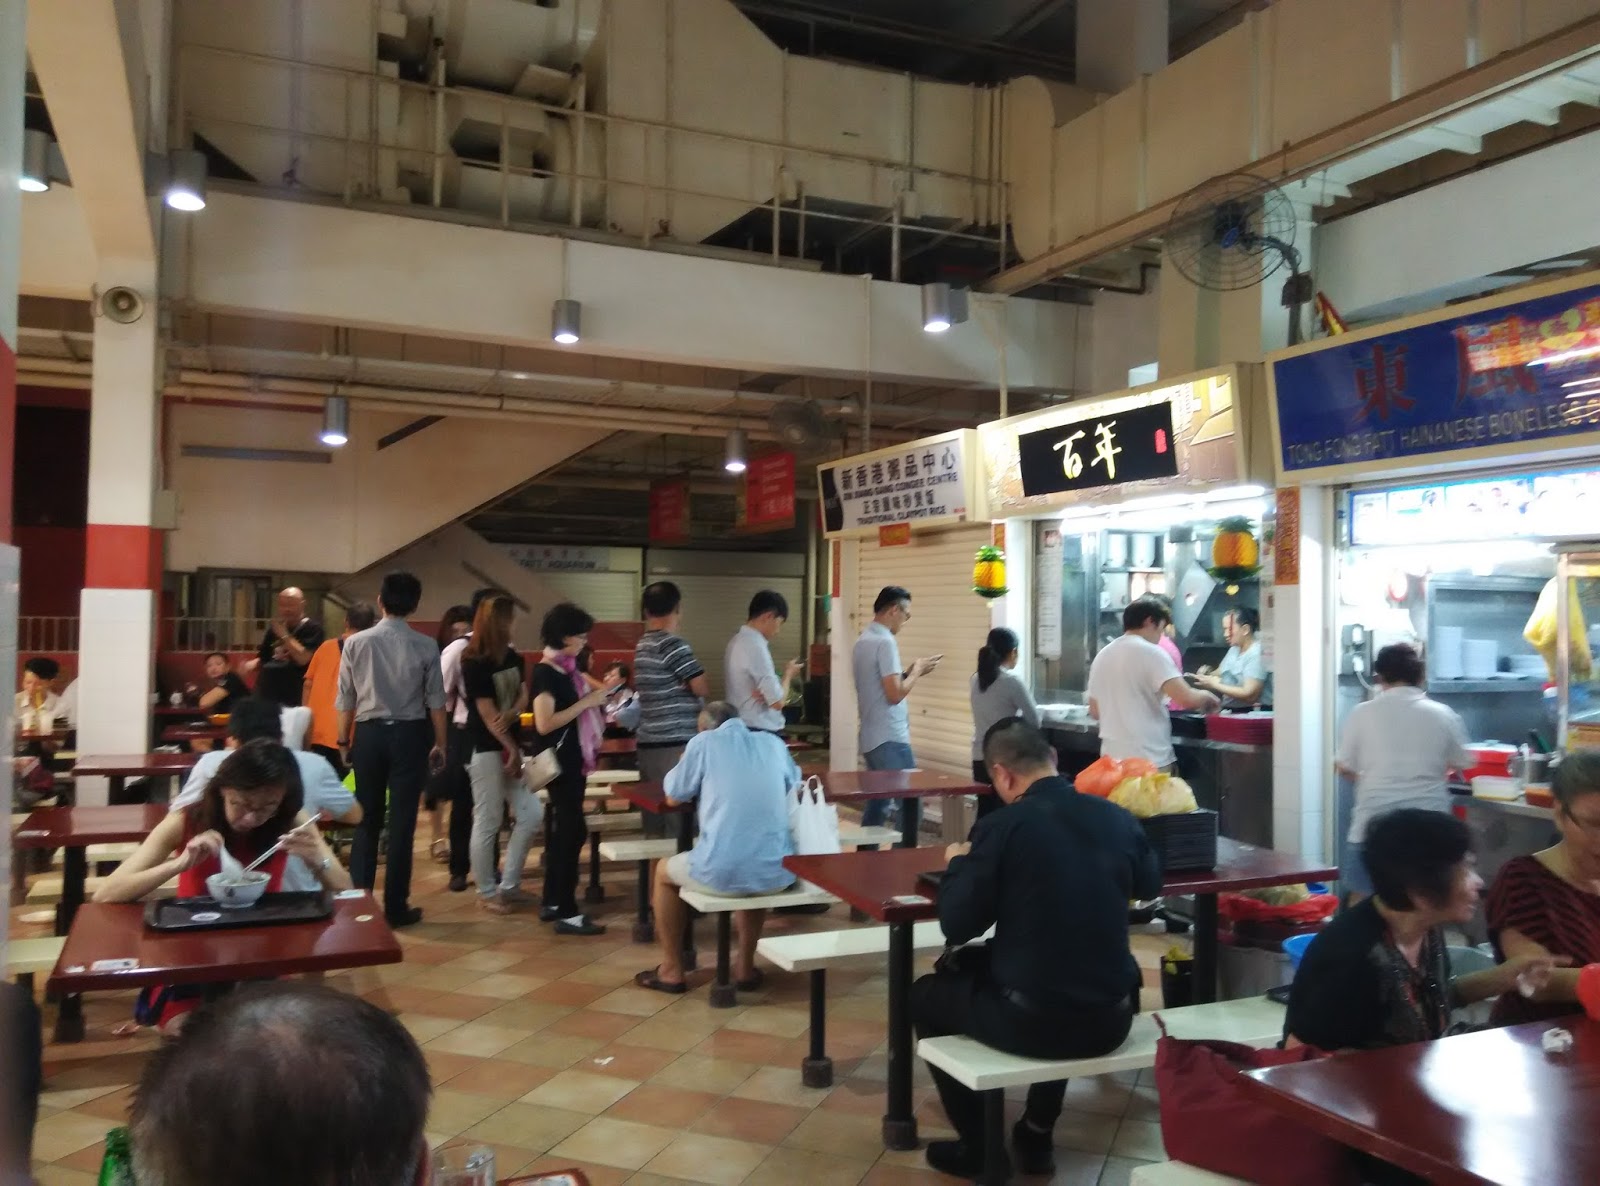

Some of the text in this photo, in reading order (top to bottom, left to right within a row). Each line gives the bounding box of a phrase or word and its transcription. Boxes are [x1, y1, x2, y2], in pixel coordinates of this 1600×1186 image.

[1401, 416, 1485, 448] HAINANESE
[1053, 420, 1123, 480] 百年
[927, 471, 958, 486] CENTRE
[857, 513, 895, 525] TRADITIONAL
[897, 510, 927, 522] CLAYPOT
[929, 506, 946, 516] RICE
[548, 560, 595, 569] AQUARIUM
